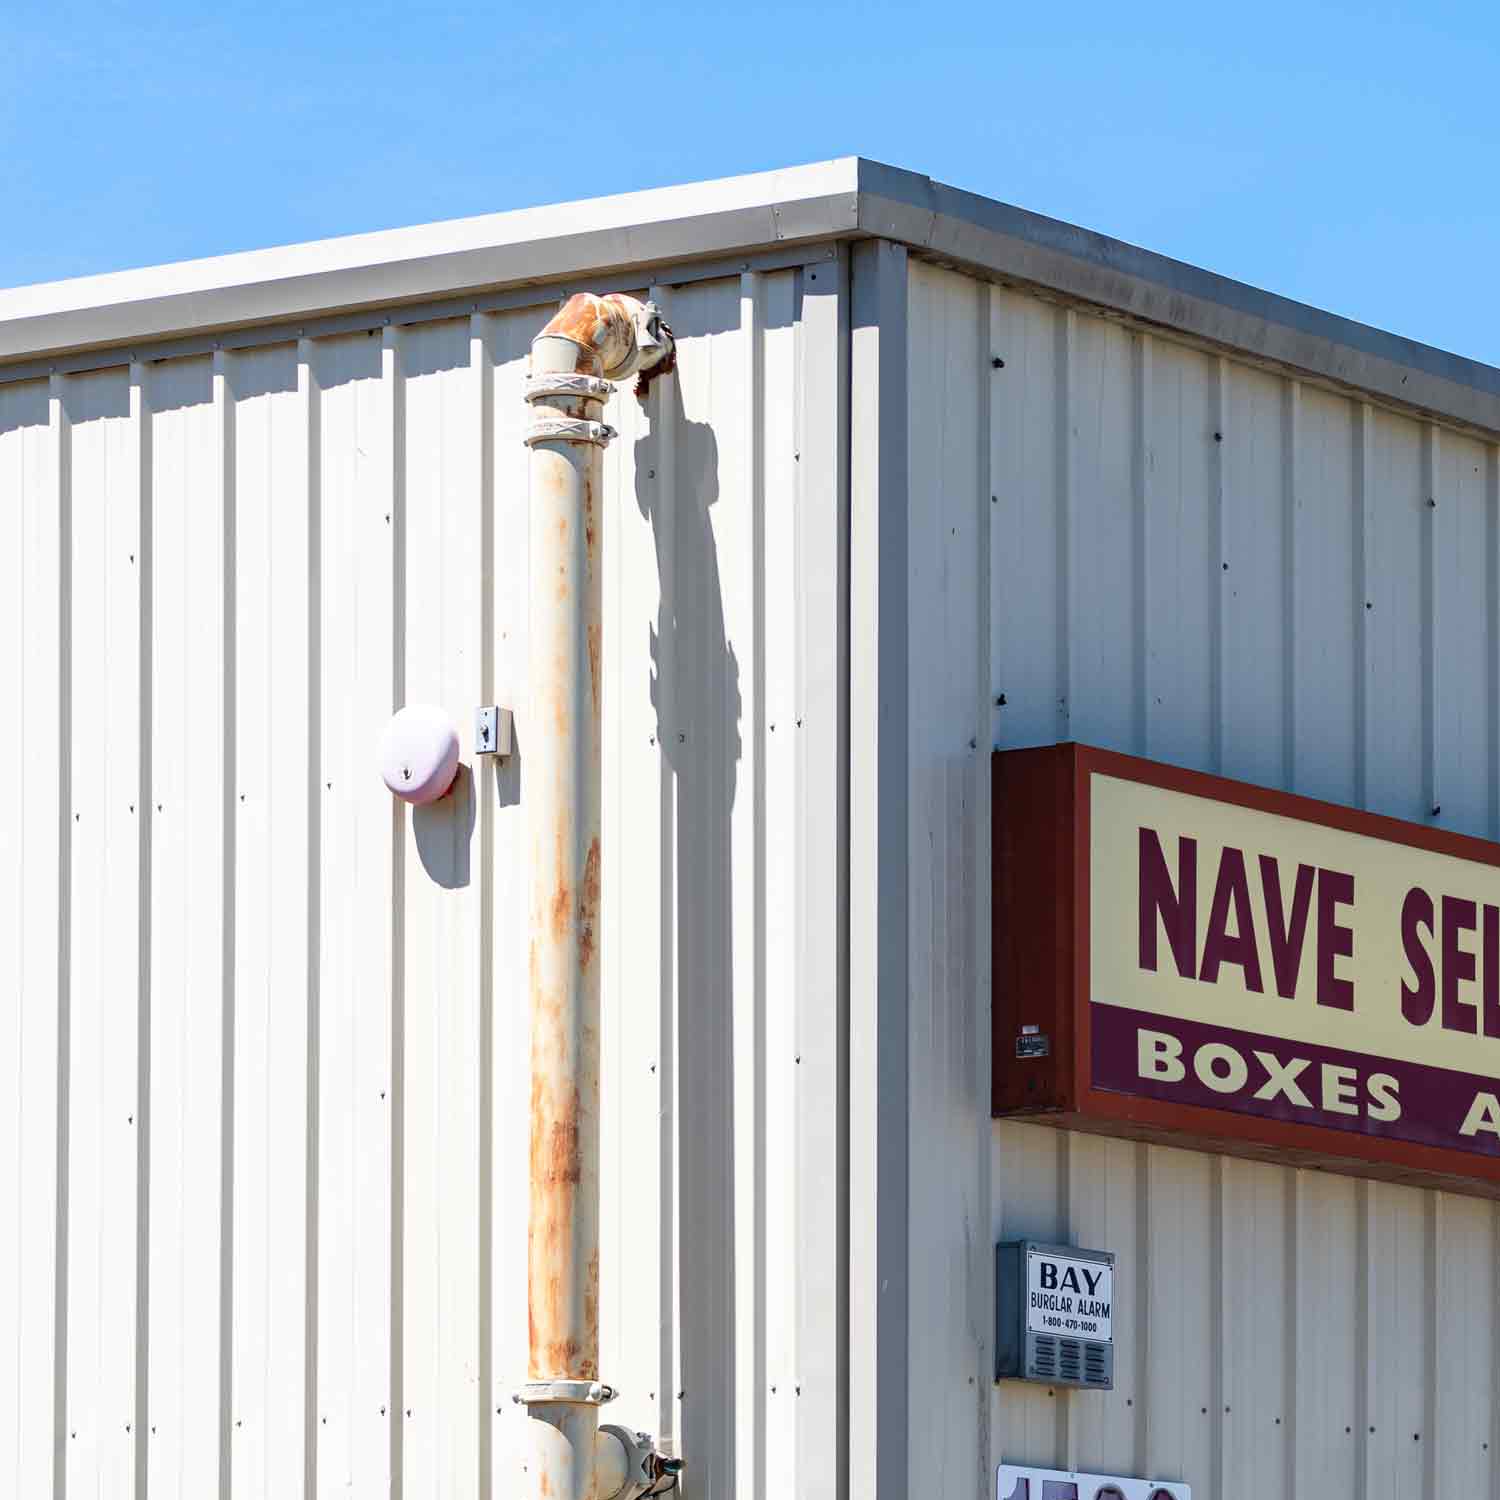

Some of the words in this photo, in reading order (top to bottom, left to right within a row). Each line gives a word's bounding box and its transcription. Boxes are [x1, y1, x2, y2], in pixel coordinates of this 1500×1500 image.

[1138, 827, 1355, 1011] NAVE
[1137, 1028, 1401, 1122] BOXES
[1031, 1291, 1073, 1313] BURGLAR
[1077, 1298, 1110, 1319] ALARM
[1040, 1262, 1102, 1296] BAY
